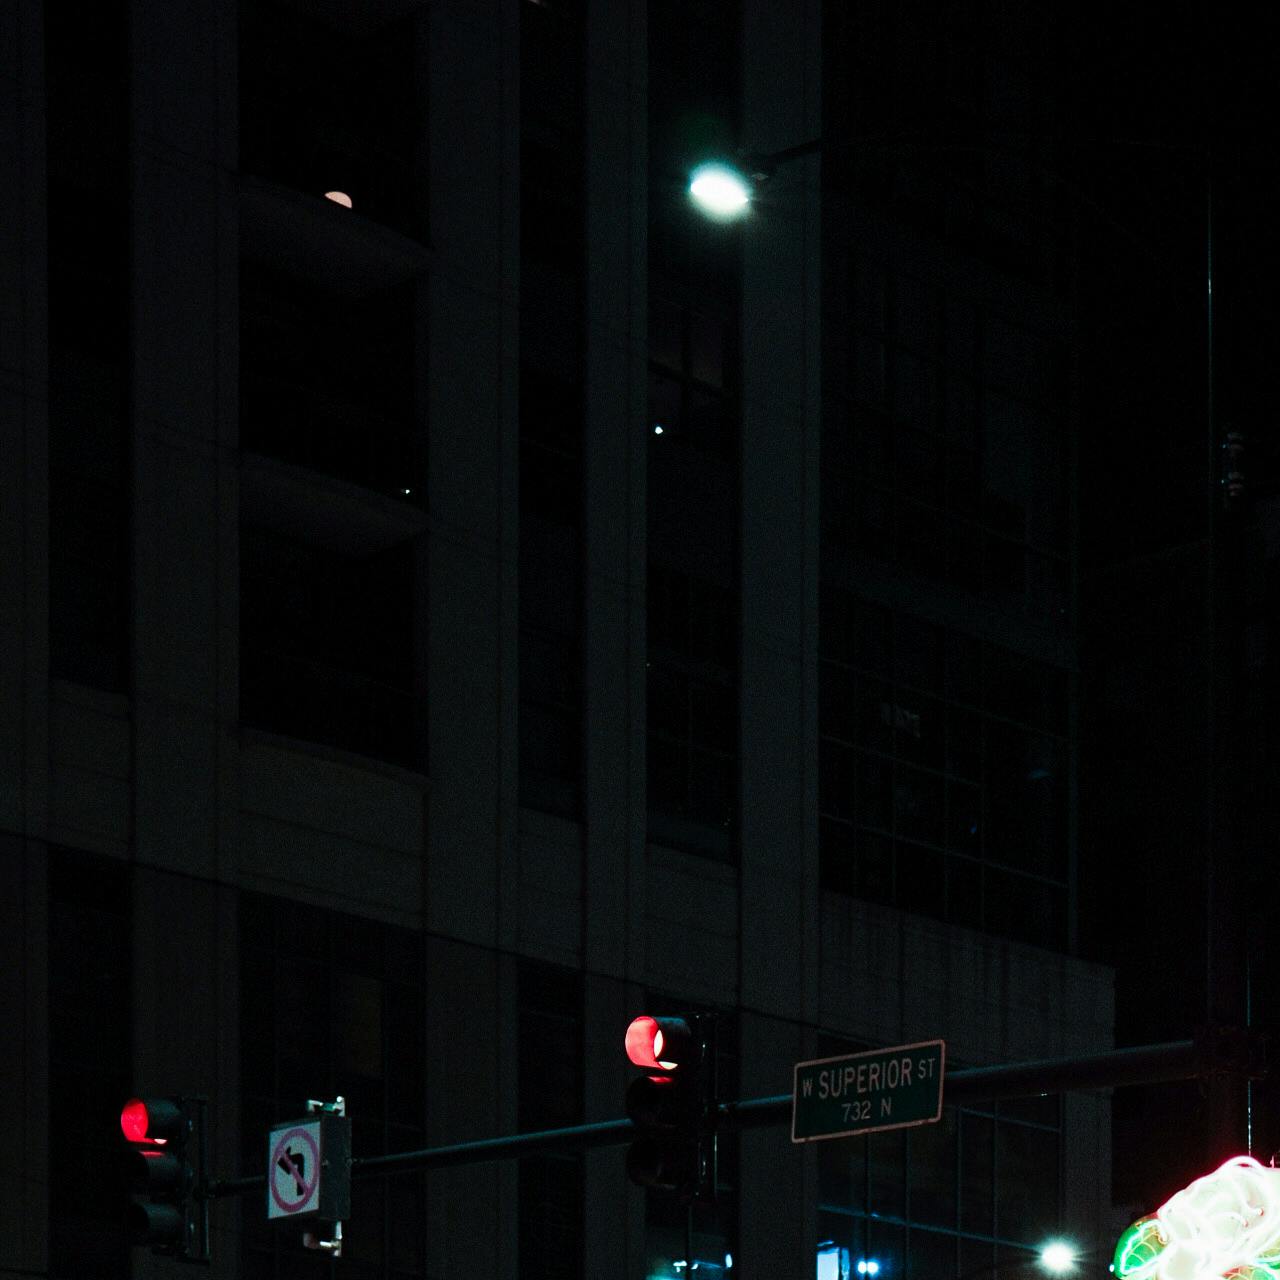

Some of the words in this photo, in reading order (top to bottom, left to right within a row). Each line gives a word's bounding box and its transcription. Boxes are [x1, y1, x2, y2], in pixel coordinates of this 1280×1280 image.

[802, 1077, 813, 1099] W
[818, 1057, 913, 1100] SUPERIOR
[917, 1058, 936, 1080] ST
[841, 1101, 872, 1123] 732
[880, 1097, 892, 1118] N
